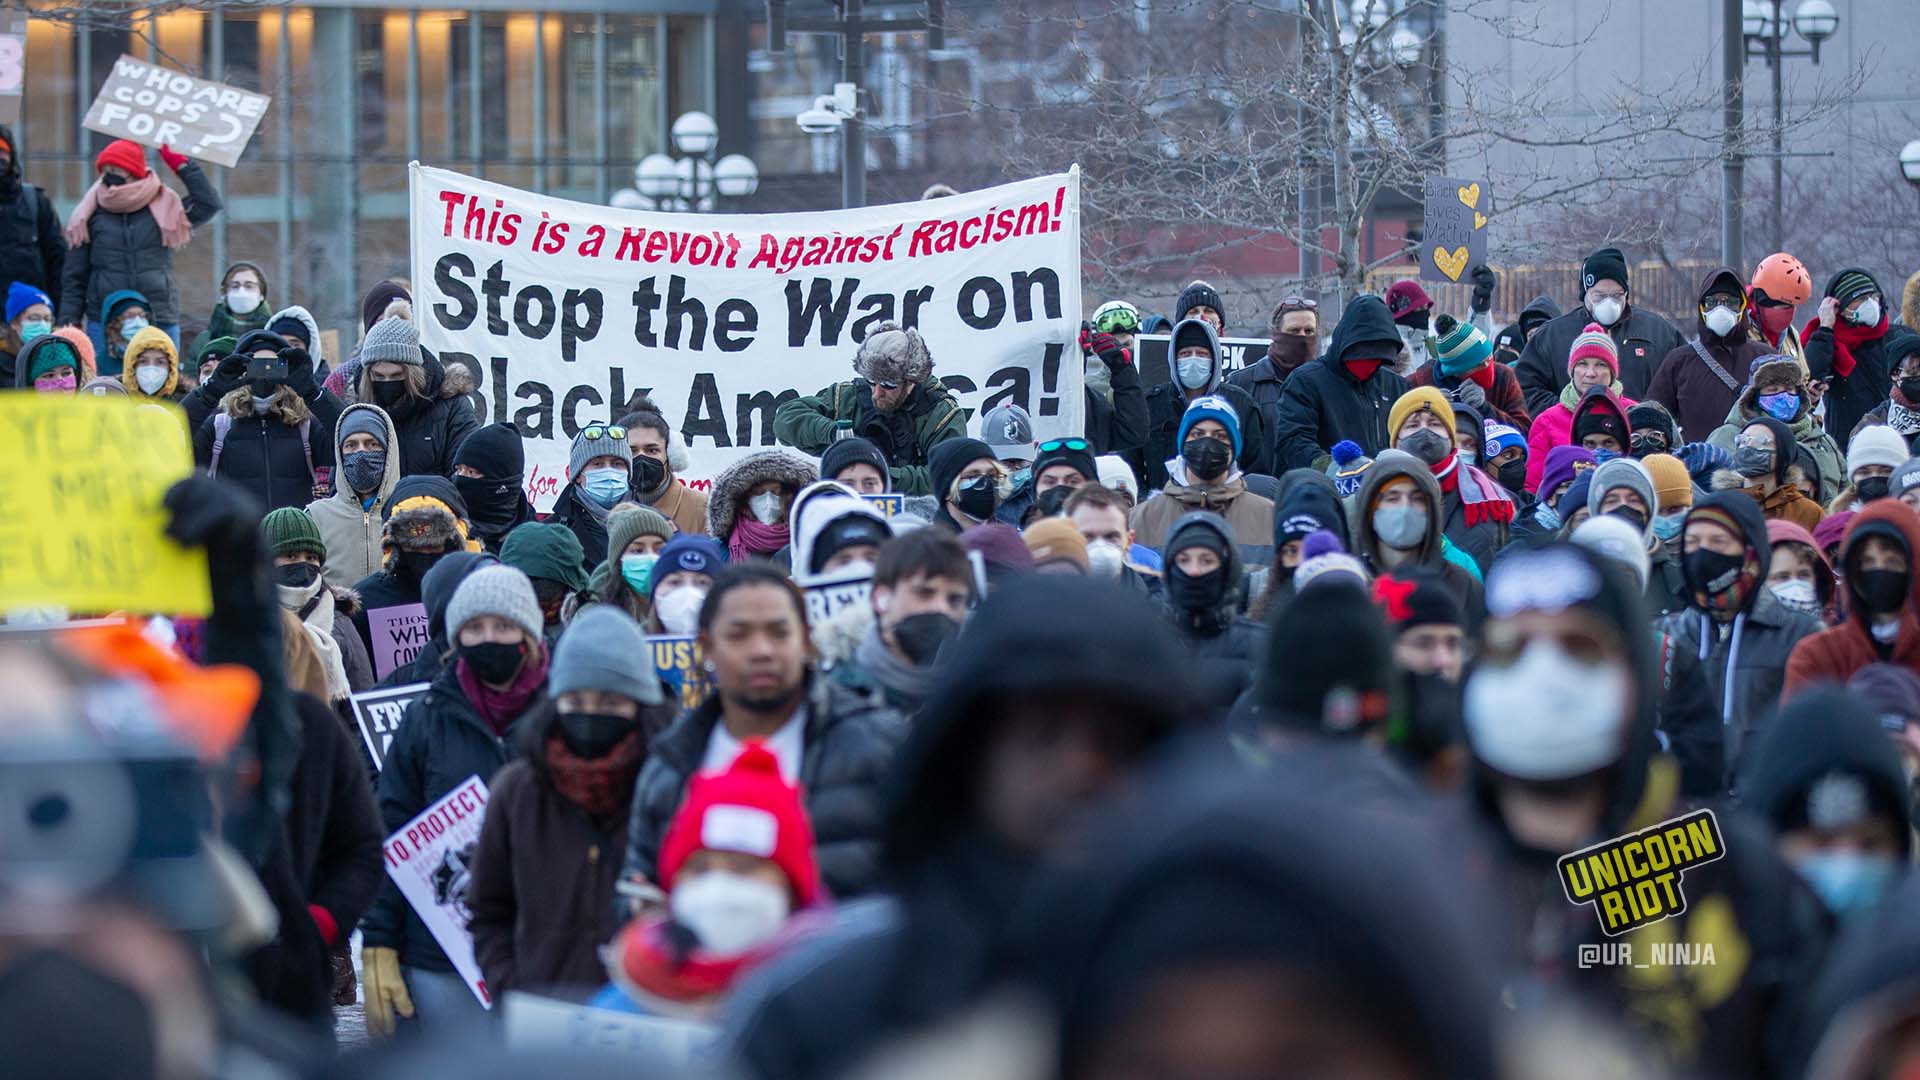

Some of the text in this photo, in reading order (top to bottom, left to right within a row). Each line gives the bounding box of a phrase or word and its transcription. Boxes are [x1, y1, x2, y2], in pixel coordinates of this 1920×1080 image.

[114, 86, 208, 123] COPS
[116, 61, 265, 117] WHO ARE
[1425, 180, 1458, 200] Black
[1425, 200, 1460, 220] Lives
[439, 187, 1066, 274] This is a Revolt Against Racism!
[433, 252, 1062, 362] Stop the War on
[527, 464, 558, 504] for
[387, 615, 428, 627] THOS
[390, 625, 428, 645] WH
[384, 839, 410, 868] TO
[406, 783, 487, 851] PROTECT
